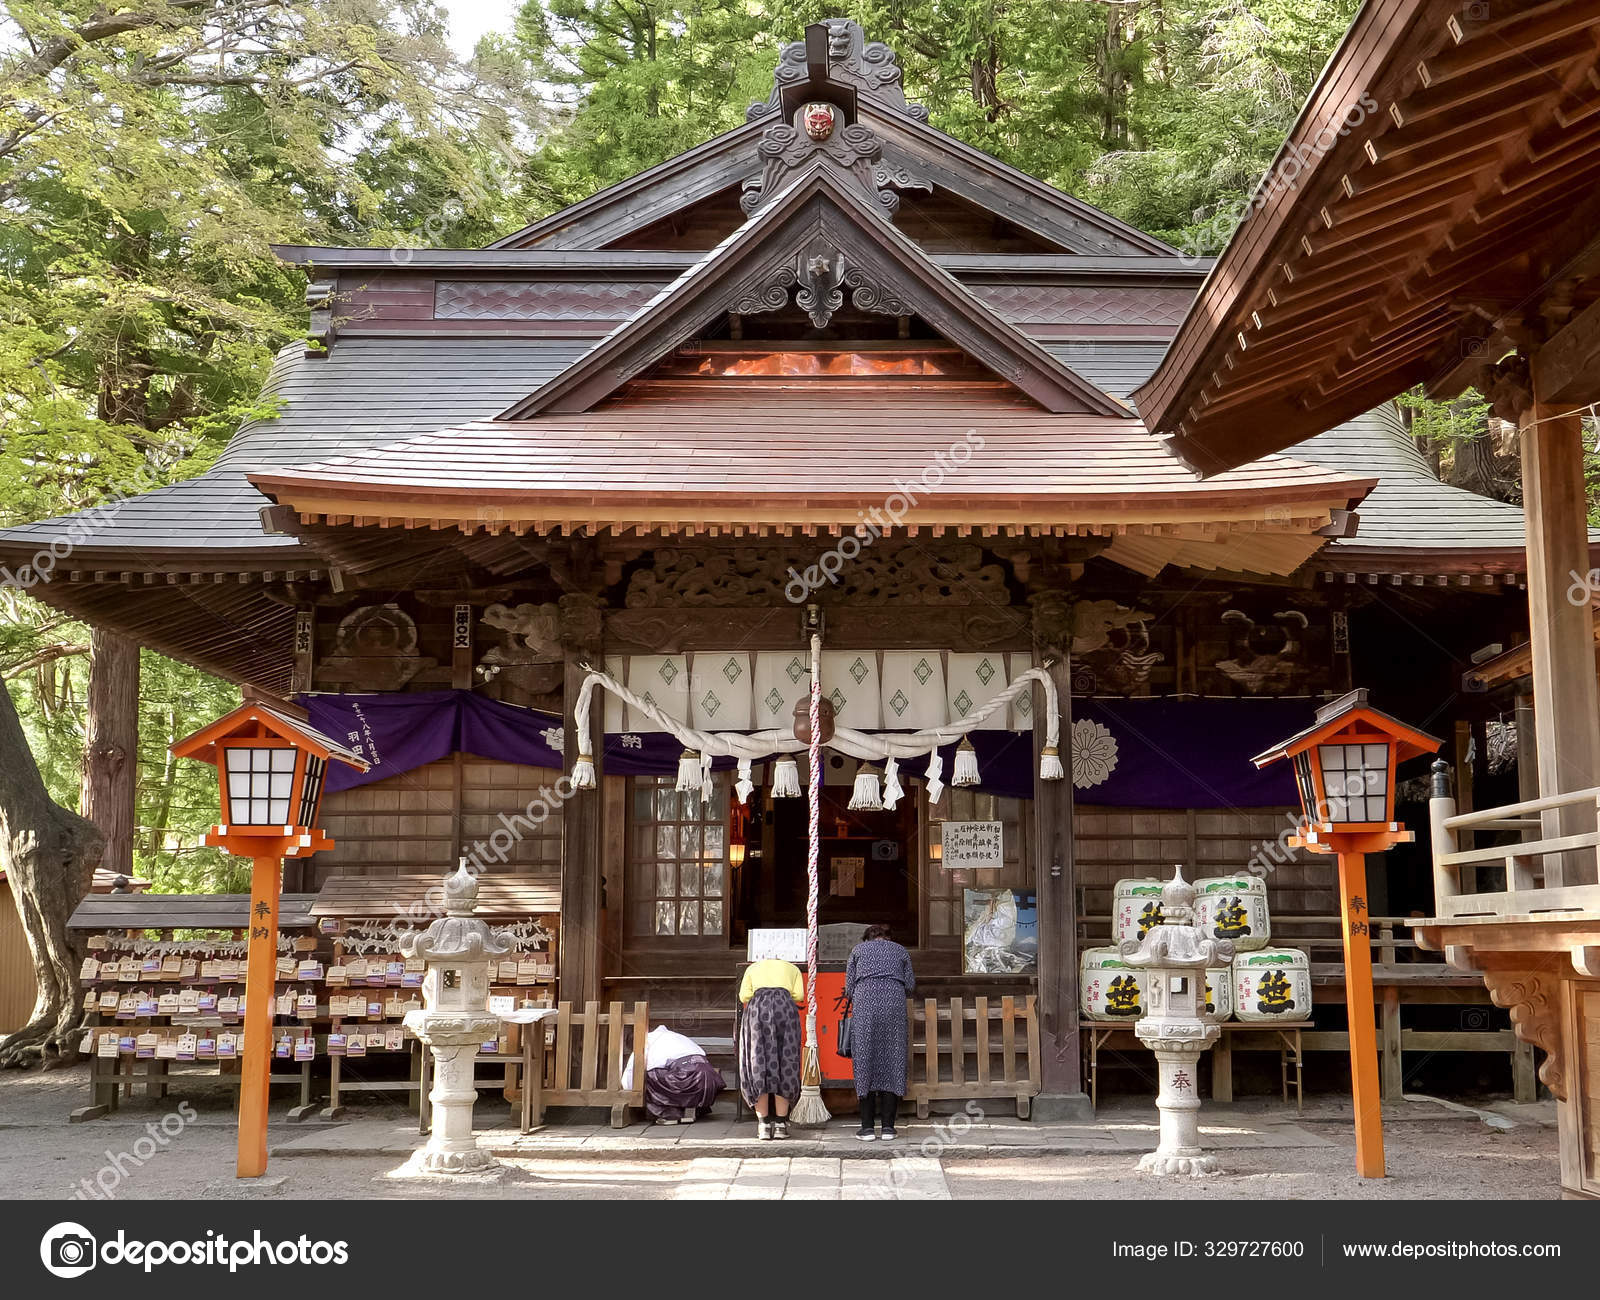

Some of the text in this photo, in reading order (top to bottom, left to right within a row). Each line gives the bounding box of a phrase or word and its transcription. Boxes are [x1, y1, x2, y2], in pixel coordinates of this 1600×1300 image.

[253, 900, 272, 940] 奉納
[1350, 895, 1368, 937] 奉納
[1171, 1069, 1192, 1091] 奉
